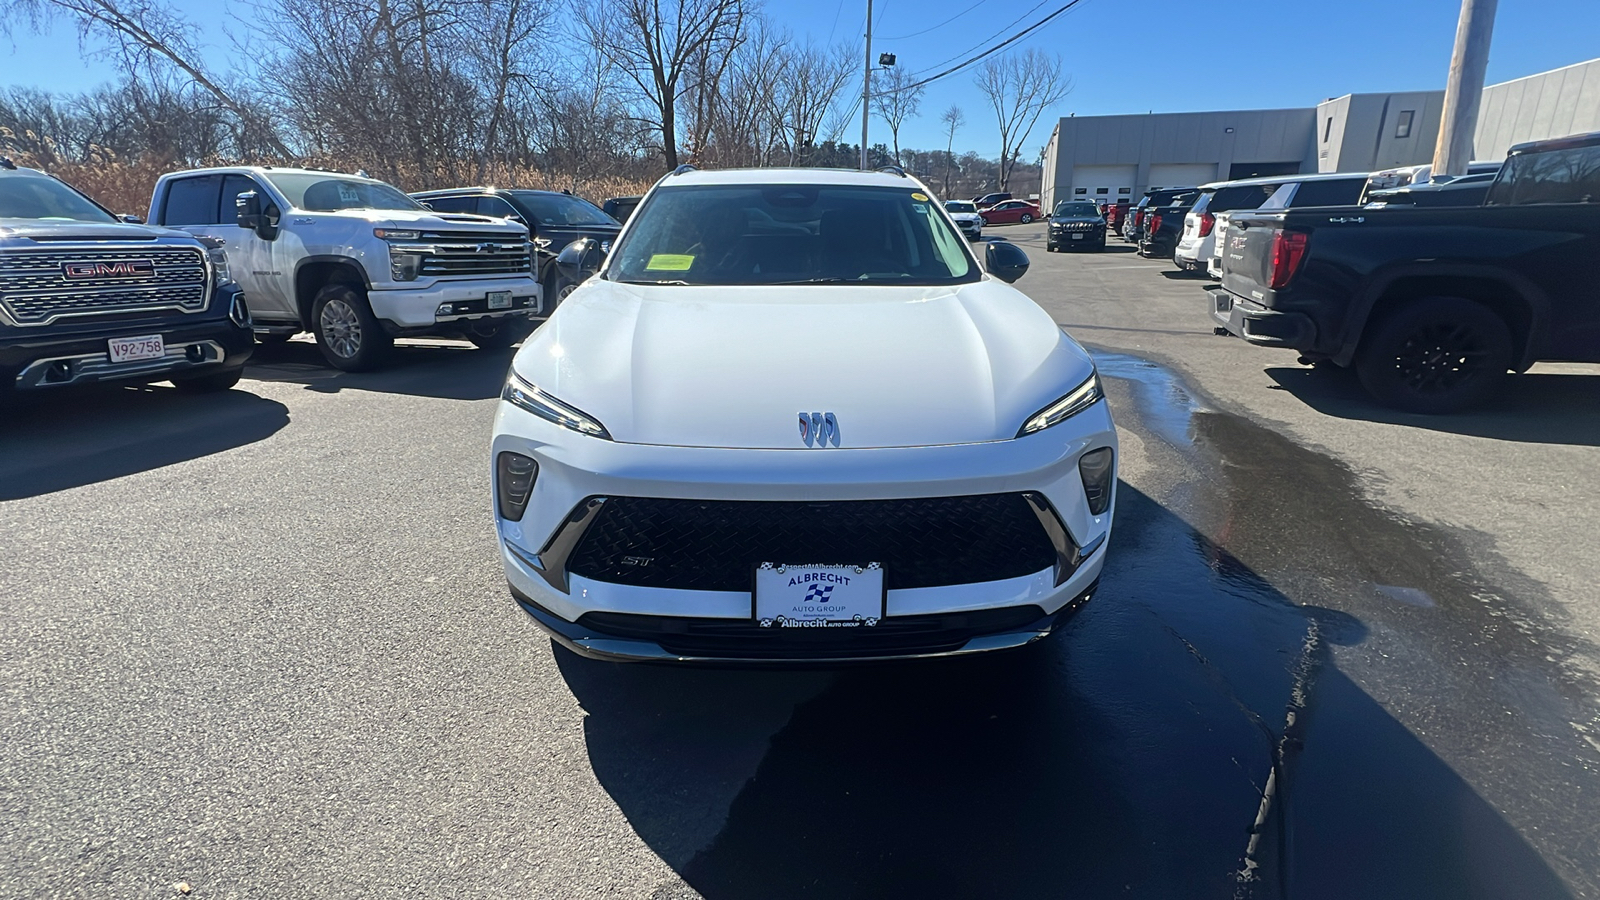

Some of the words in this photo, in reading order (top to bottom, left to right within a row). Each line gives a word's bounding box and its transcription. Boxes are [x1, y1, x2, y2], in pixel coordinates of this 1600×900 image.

[65, 262, 153, 278] GMC
[788, 572, 851, 587] ALBRECHT
[781, 618, 828, 628] Albrecht
